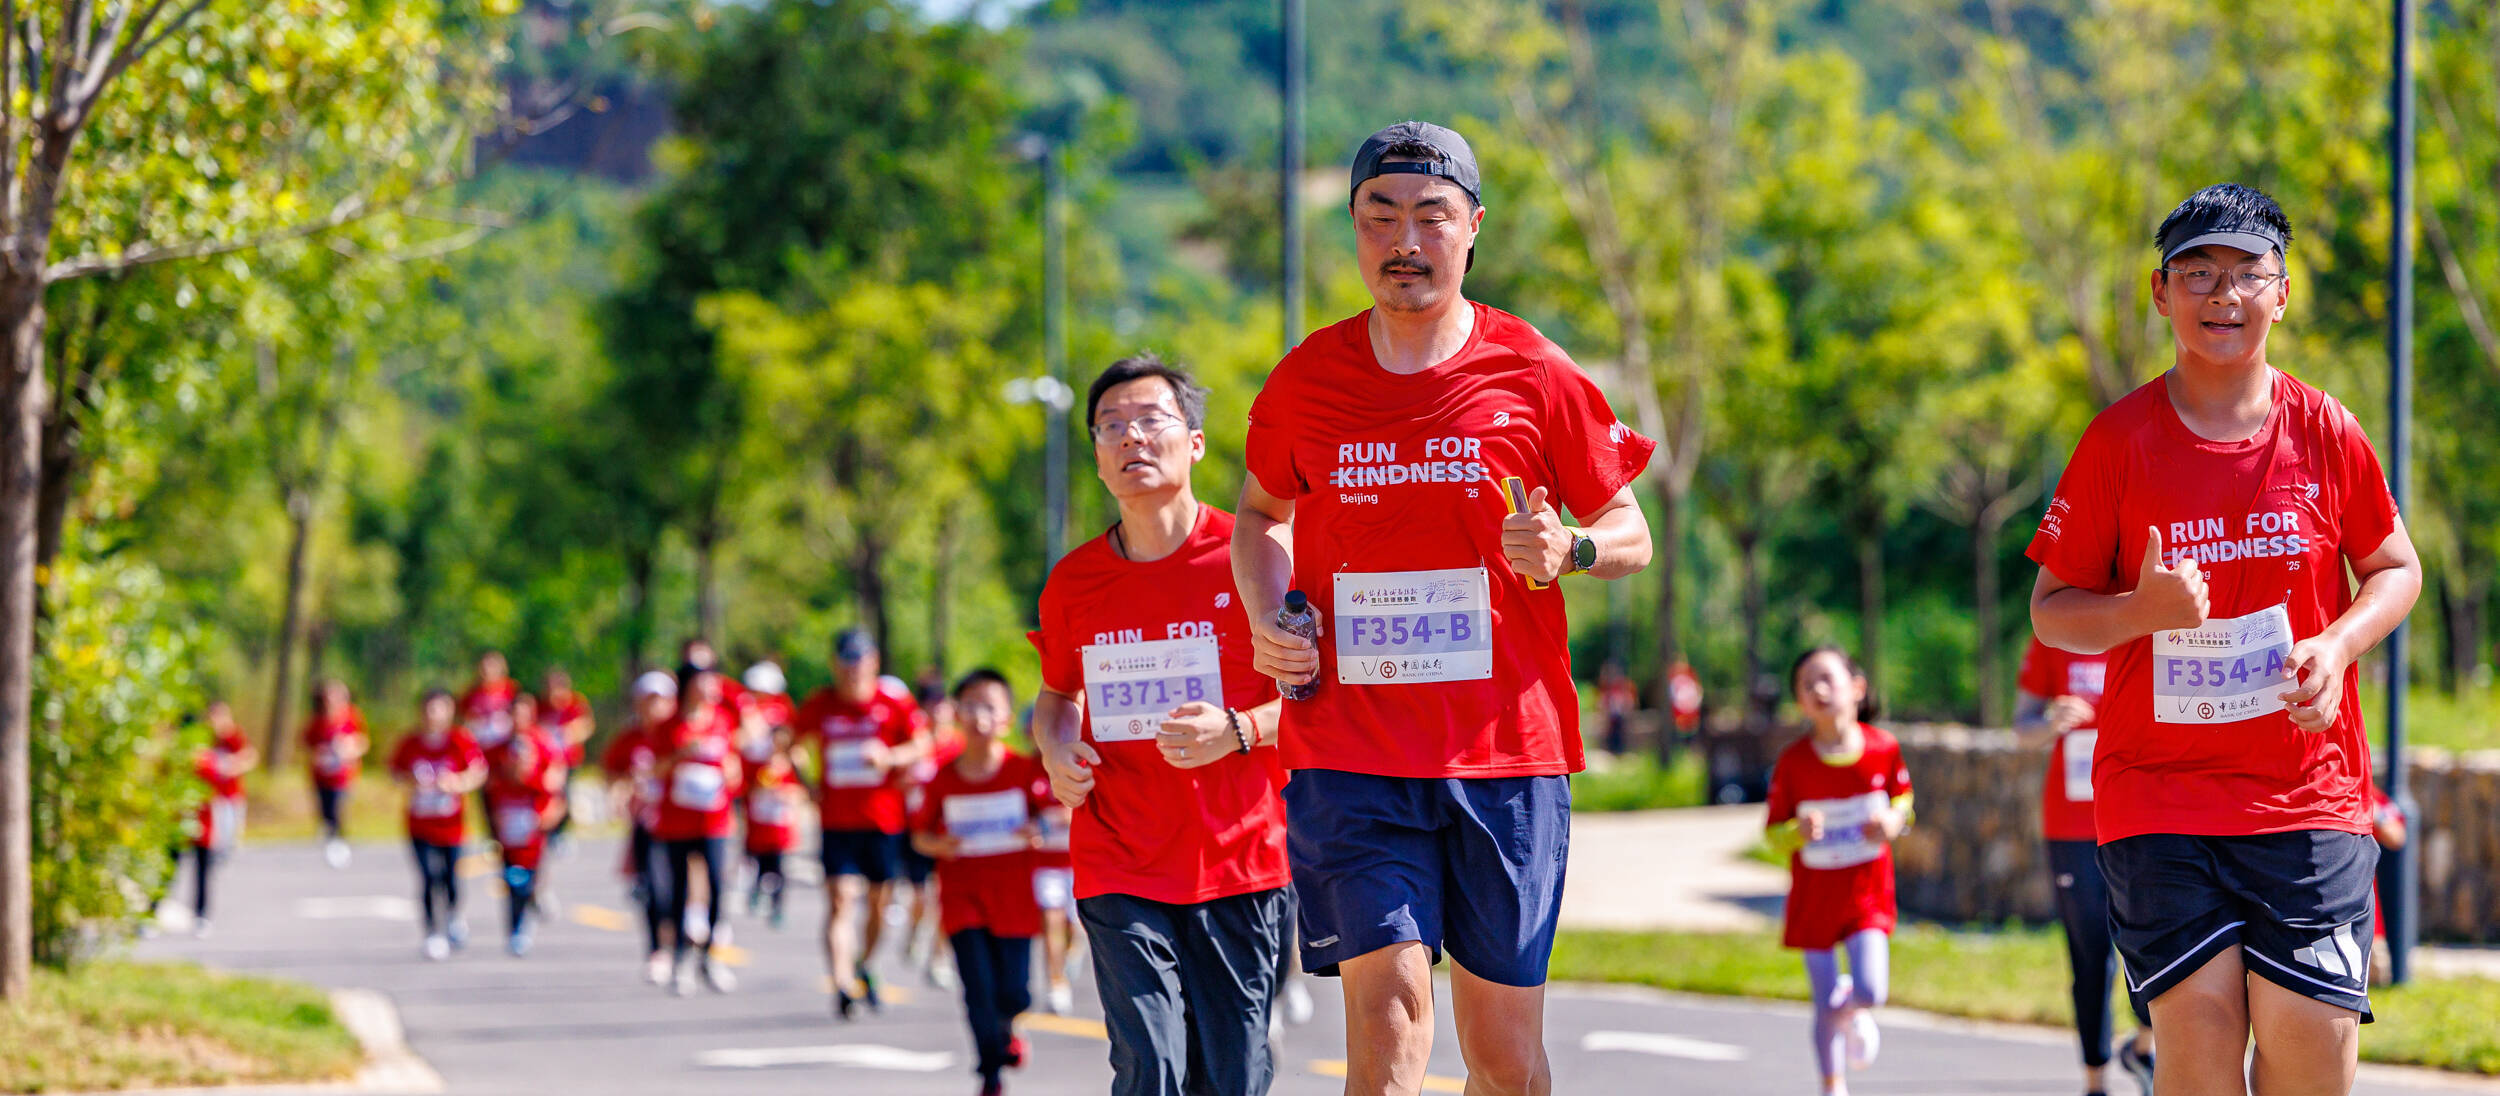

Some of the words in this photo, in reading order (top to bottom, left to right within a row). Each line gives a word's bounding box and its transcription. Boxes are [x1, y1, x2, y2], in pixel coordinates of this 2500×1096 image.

[1338, 442, 1396, 464] RUN
[1425, 436, 1481, 459] FOR
[1337, 461, 1481, 488] KINDNESS
[1340, 493, 1378, 505] Beijing
[1465, 488, 1479, 499] '25
[2047, 522, 2061, 537] RUN
[2170, 517, 2225, 544] RUN
[2246, 511, 2299, 534] FOR
[2172, 534, 2301, 568] KINDNESS
[2286, 561, 2300, 571] '25
[1094, 628, 1143, 645] RUN
[1167, 621, 1214, 640] FOR
[1352, 613, 1472, 646] F354-B
[1401, 658, 1442, 671] 中国银行
[2167, 648, 2284, 687] F354-A
[1101, 677, 1204, 707] F371-B
